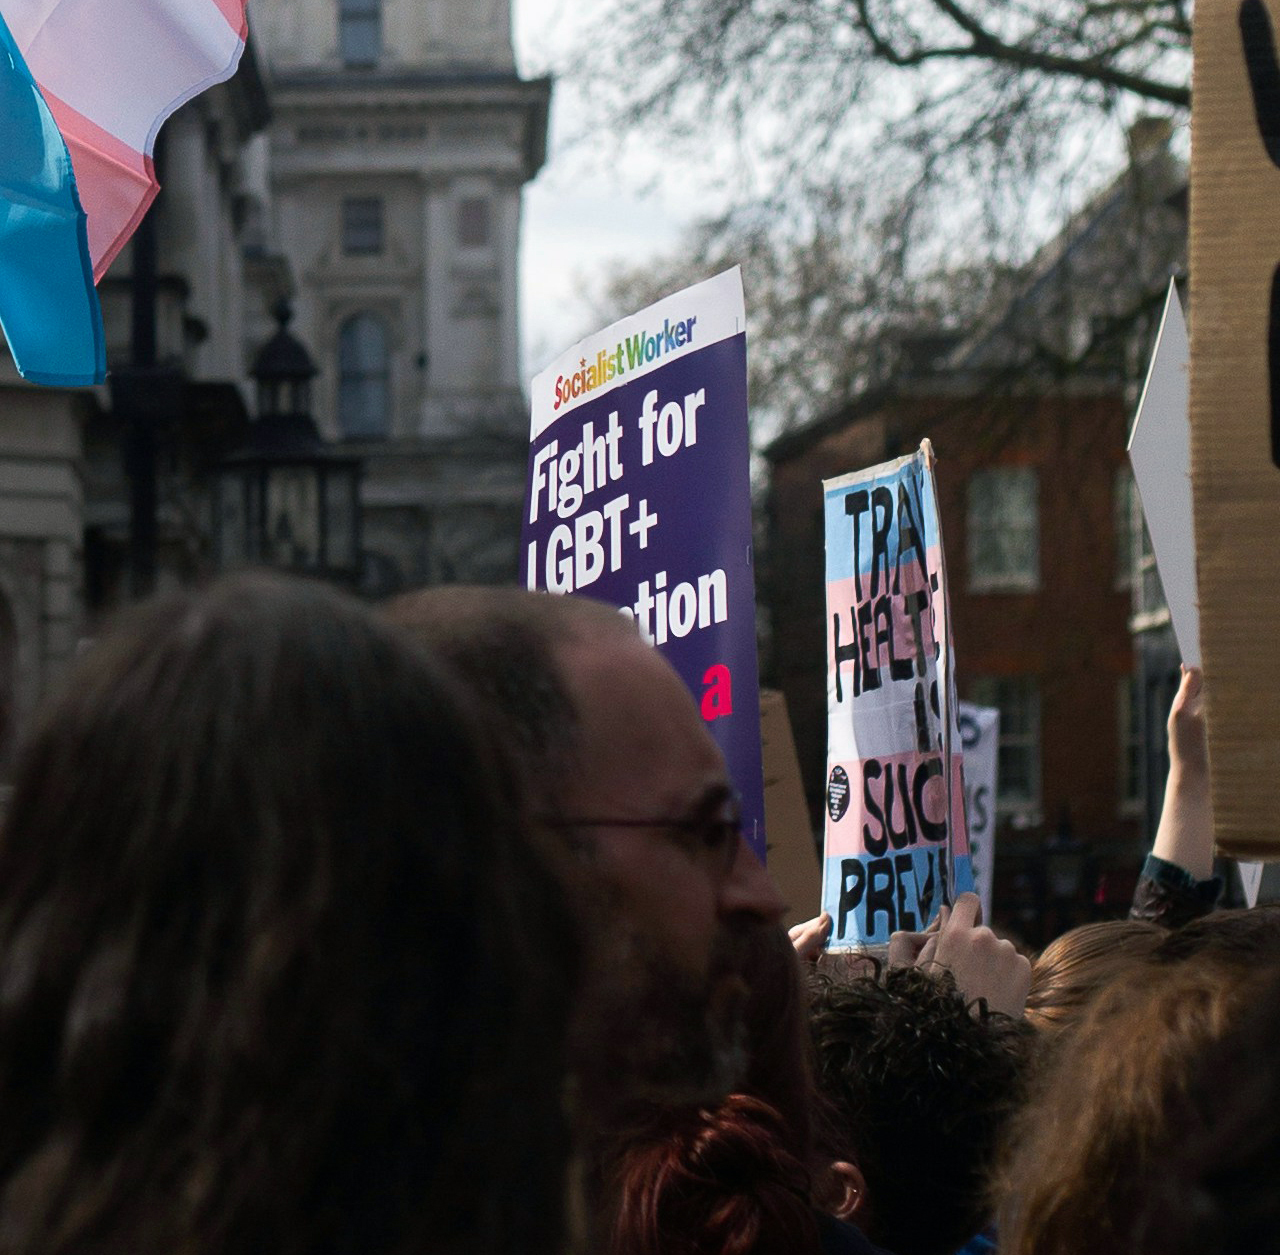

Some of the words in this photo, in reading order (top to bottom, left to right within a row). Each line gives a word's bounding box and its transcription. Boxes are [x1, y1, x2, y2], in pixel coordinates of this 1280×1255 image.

[553, 343, 624, 410] Socialist
[625, 316, 697, 370] Worker
[529, 411, 623, 525] Fight
[638, 388, 705, 466] for
[527, 493, 657, 595] LGBT+
[834, 590, 939, 703] HEALT
